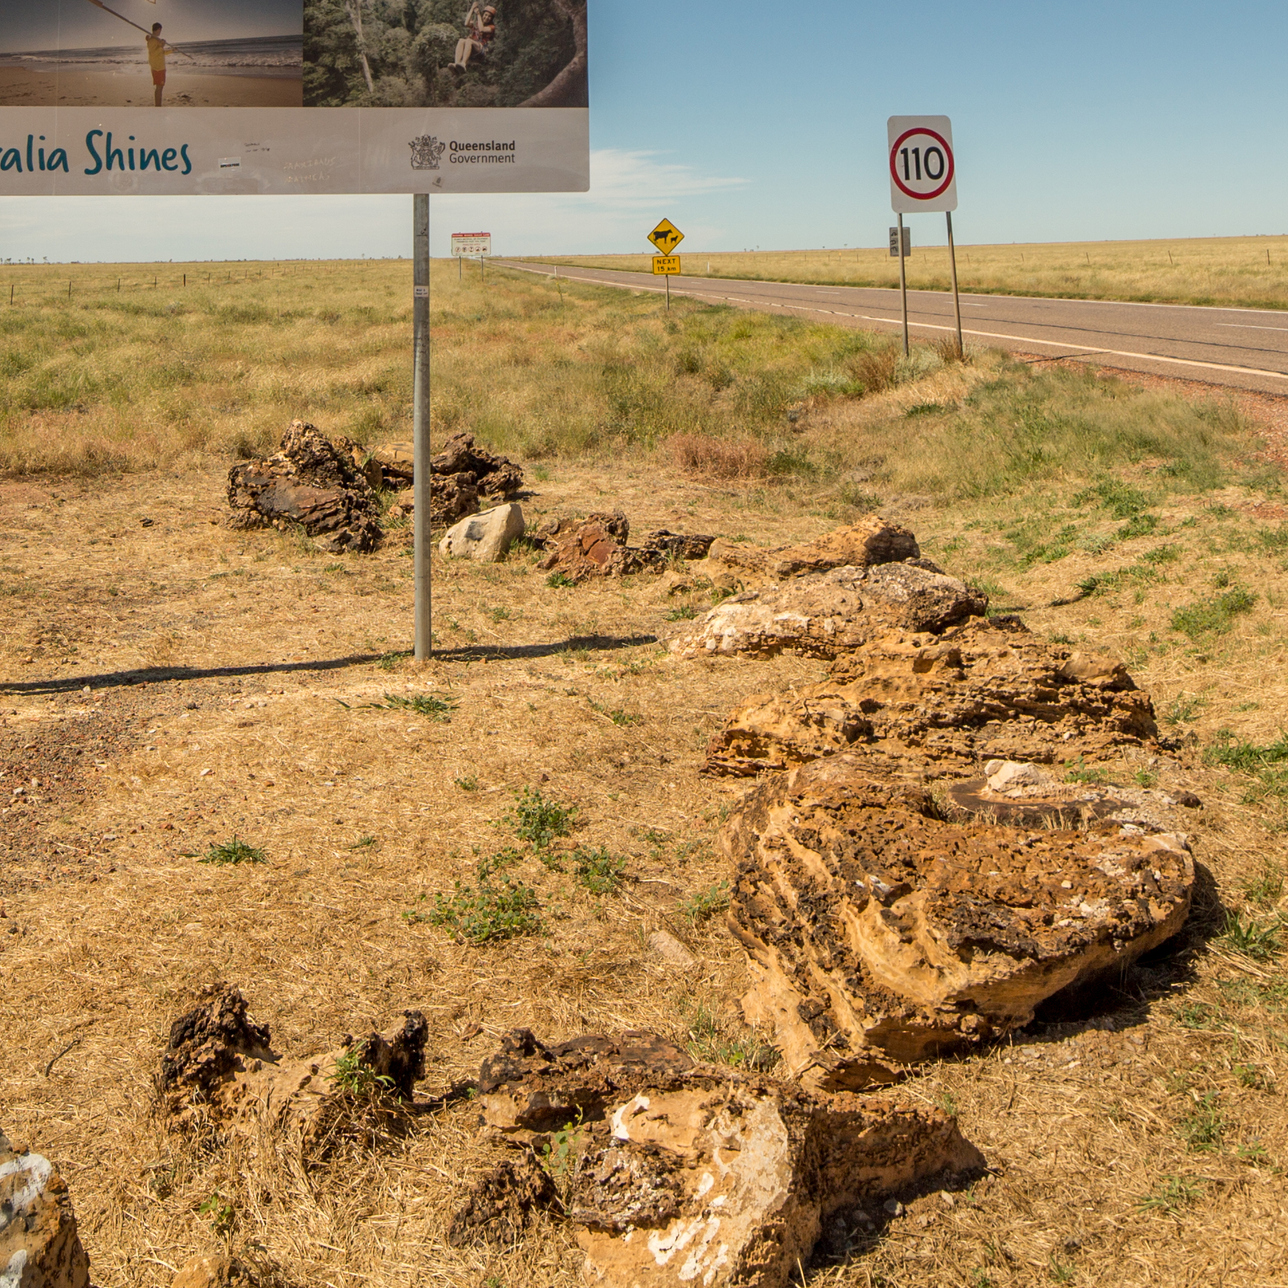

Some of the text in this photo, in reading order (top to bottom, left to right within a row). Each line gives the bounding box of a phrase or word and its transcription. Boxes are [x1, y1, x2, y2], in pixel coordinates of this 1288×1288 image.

[84, 129, 192, 175] Shines
[449, 140, 516, 152] Queensland
[449, 153, 516, 164] Government
[900, 146, 945, 181] 110
